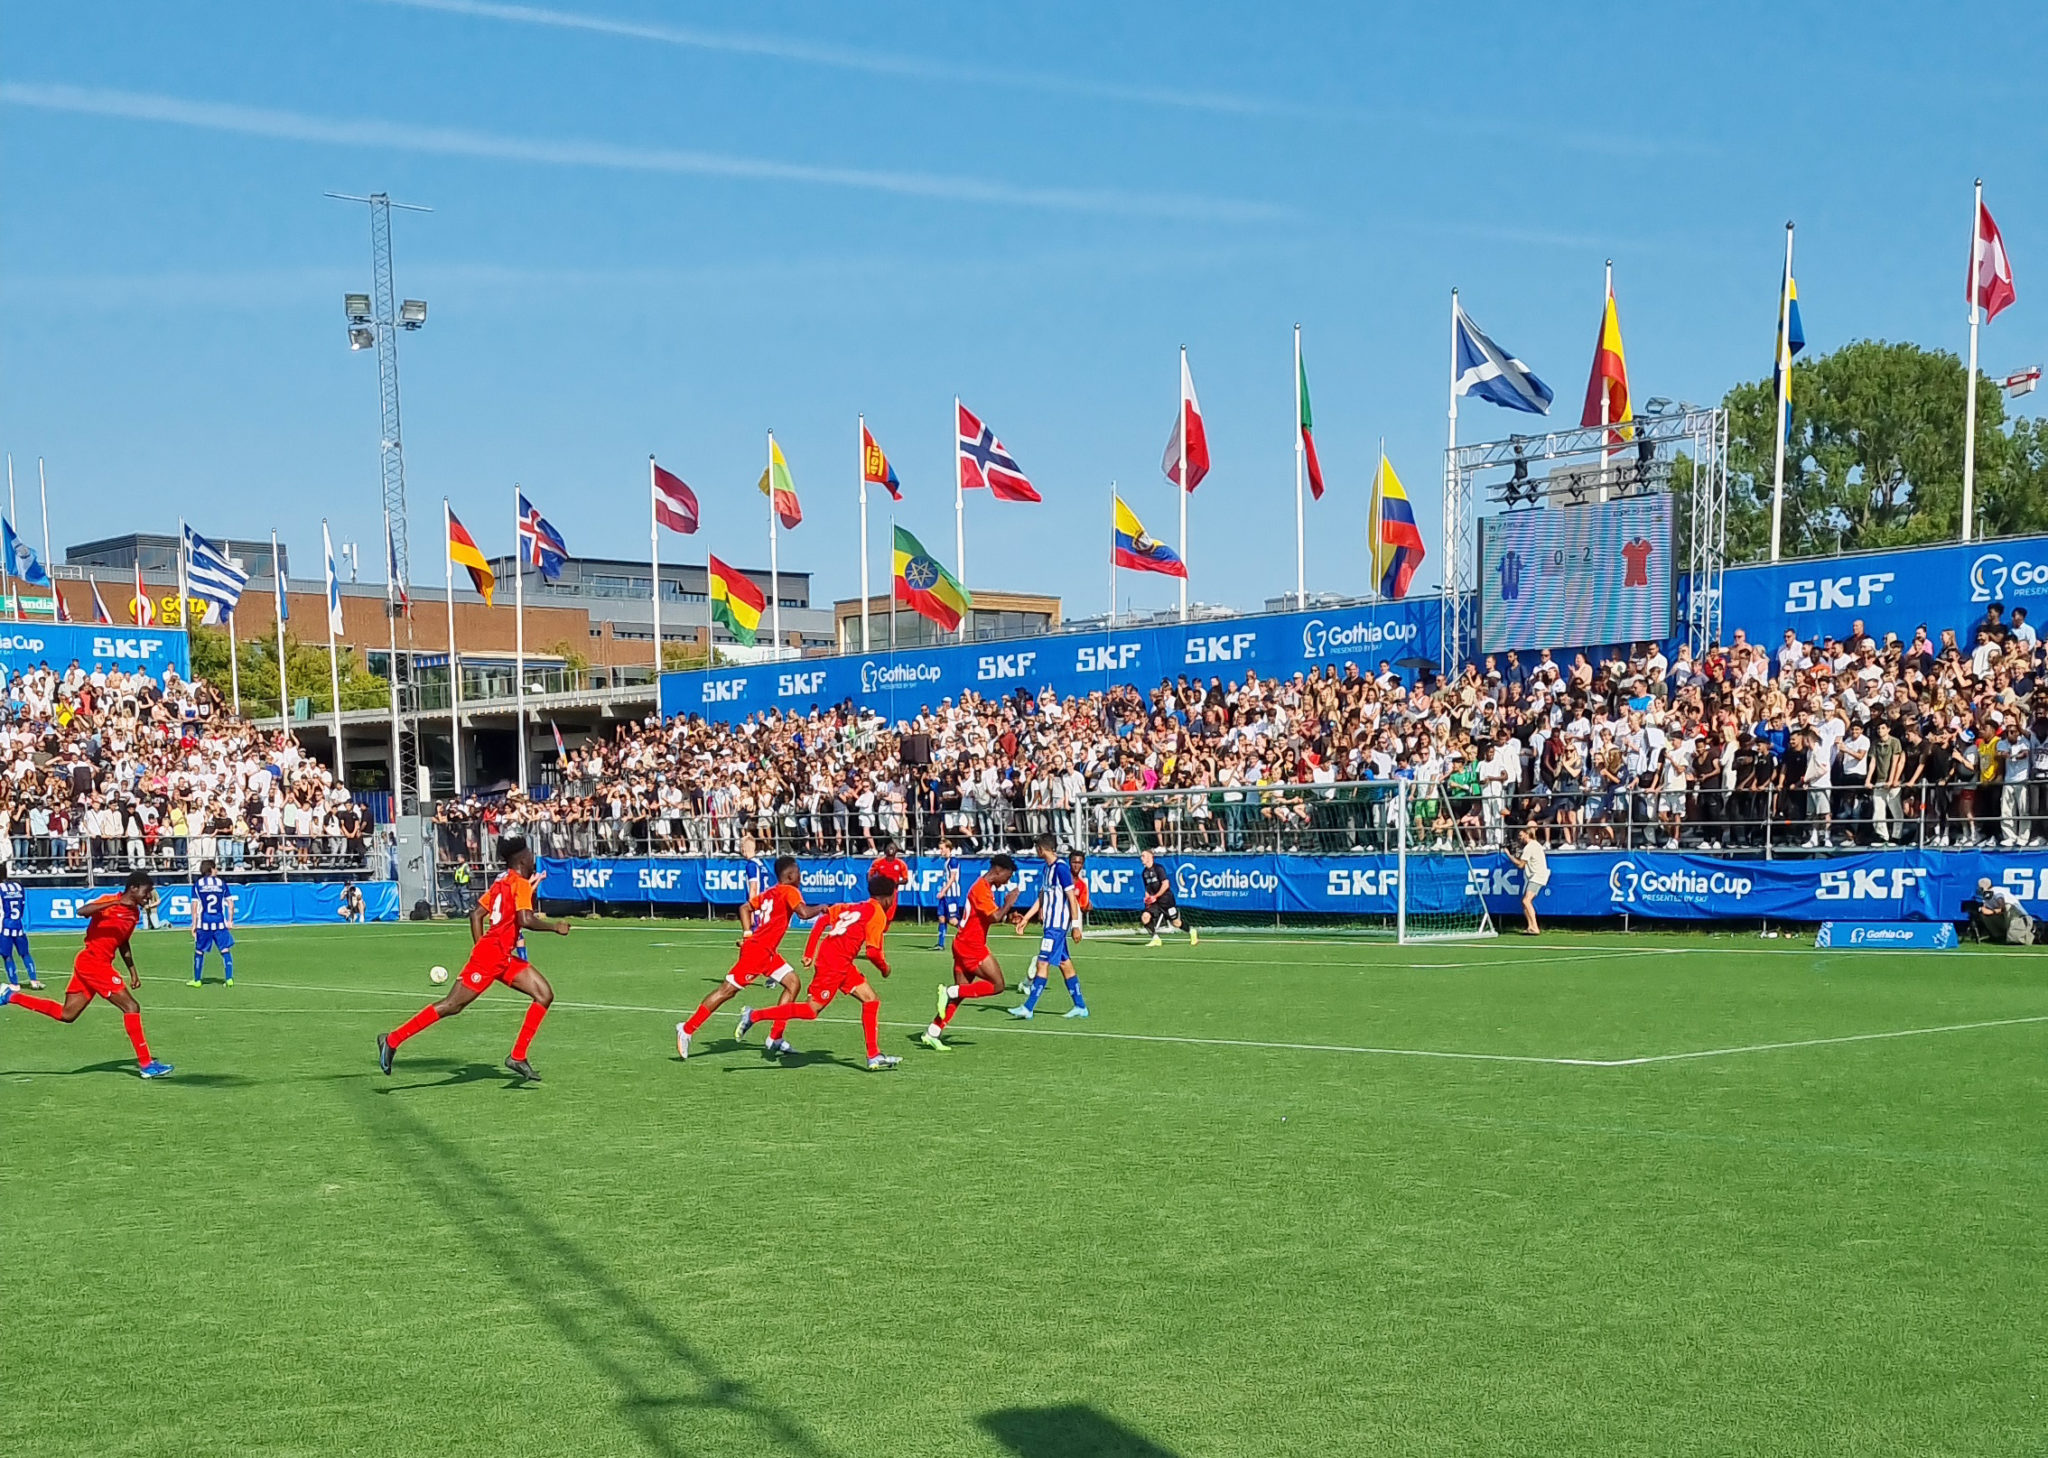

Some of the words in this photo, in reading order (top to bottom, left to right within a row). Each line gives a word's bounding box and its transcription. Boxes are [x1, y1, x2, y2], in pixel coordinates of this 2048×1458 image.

[1554, 550, 1563, 566] 0
[1582, 547, 1591, 562] 2
[1785, 573, 1895, 613] SKF
[93, 637, 163, 659] SKF
[1076, 643, 1141, 672] SKF
[1185, 633, 1256, 664] SKF
[978, 652, 1036, 680] SKF
[702, 679, 747, 702] SKF
[778, 671, 827, 697] SKF
[572, 869, 613, 888] SKF
[638, 869, 682, 889] SKF
[1327, 869, 1399, 896] SKF
[1815, 868, 1927, 900] SKF
[10, 901, 20, 919] 5
[206, 894, 218, 913] 2
